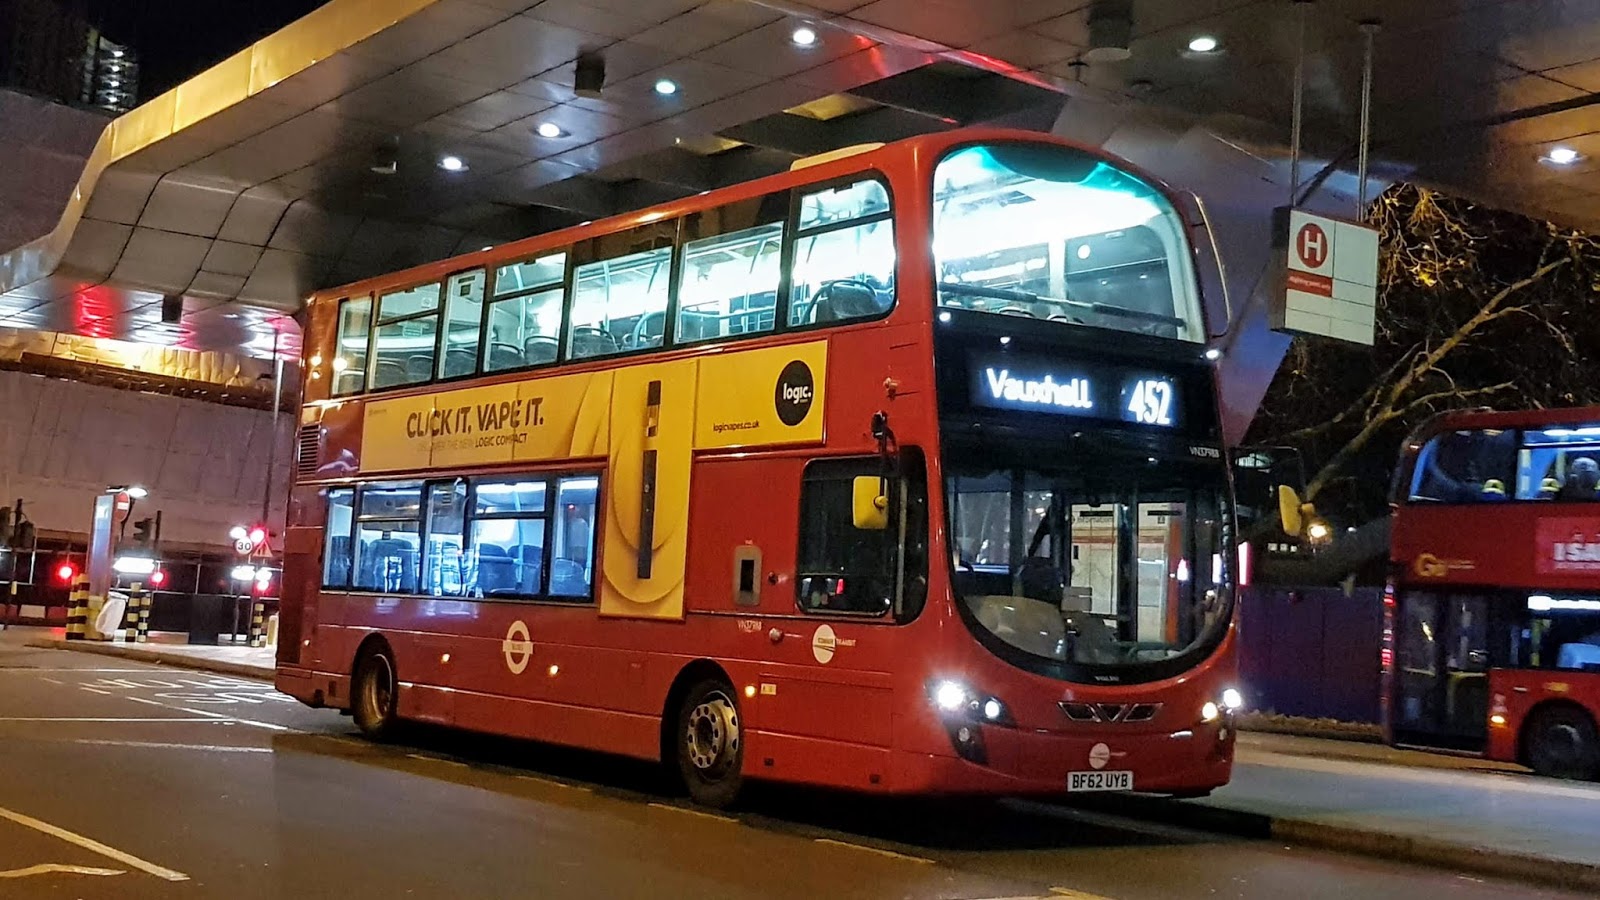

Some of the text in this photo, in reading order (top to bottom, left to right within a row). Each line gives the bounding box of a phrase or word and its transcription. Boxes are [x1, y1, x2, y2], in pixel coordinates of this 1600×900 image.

[1303, 230, 1322, 262] H
[986, 368, 1171, 425] Vauxhall 452
[406, 409, 453, 438] CLICK
[477, 399, 522, 431] VAPE
[237, 541, 251, 551] 30
[1072, 774, 1128, 789] BF62 UYB
